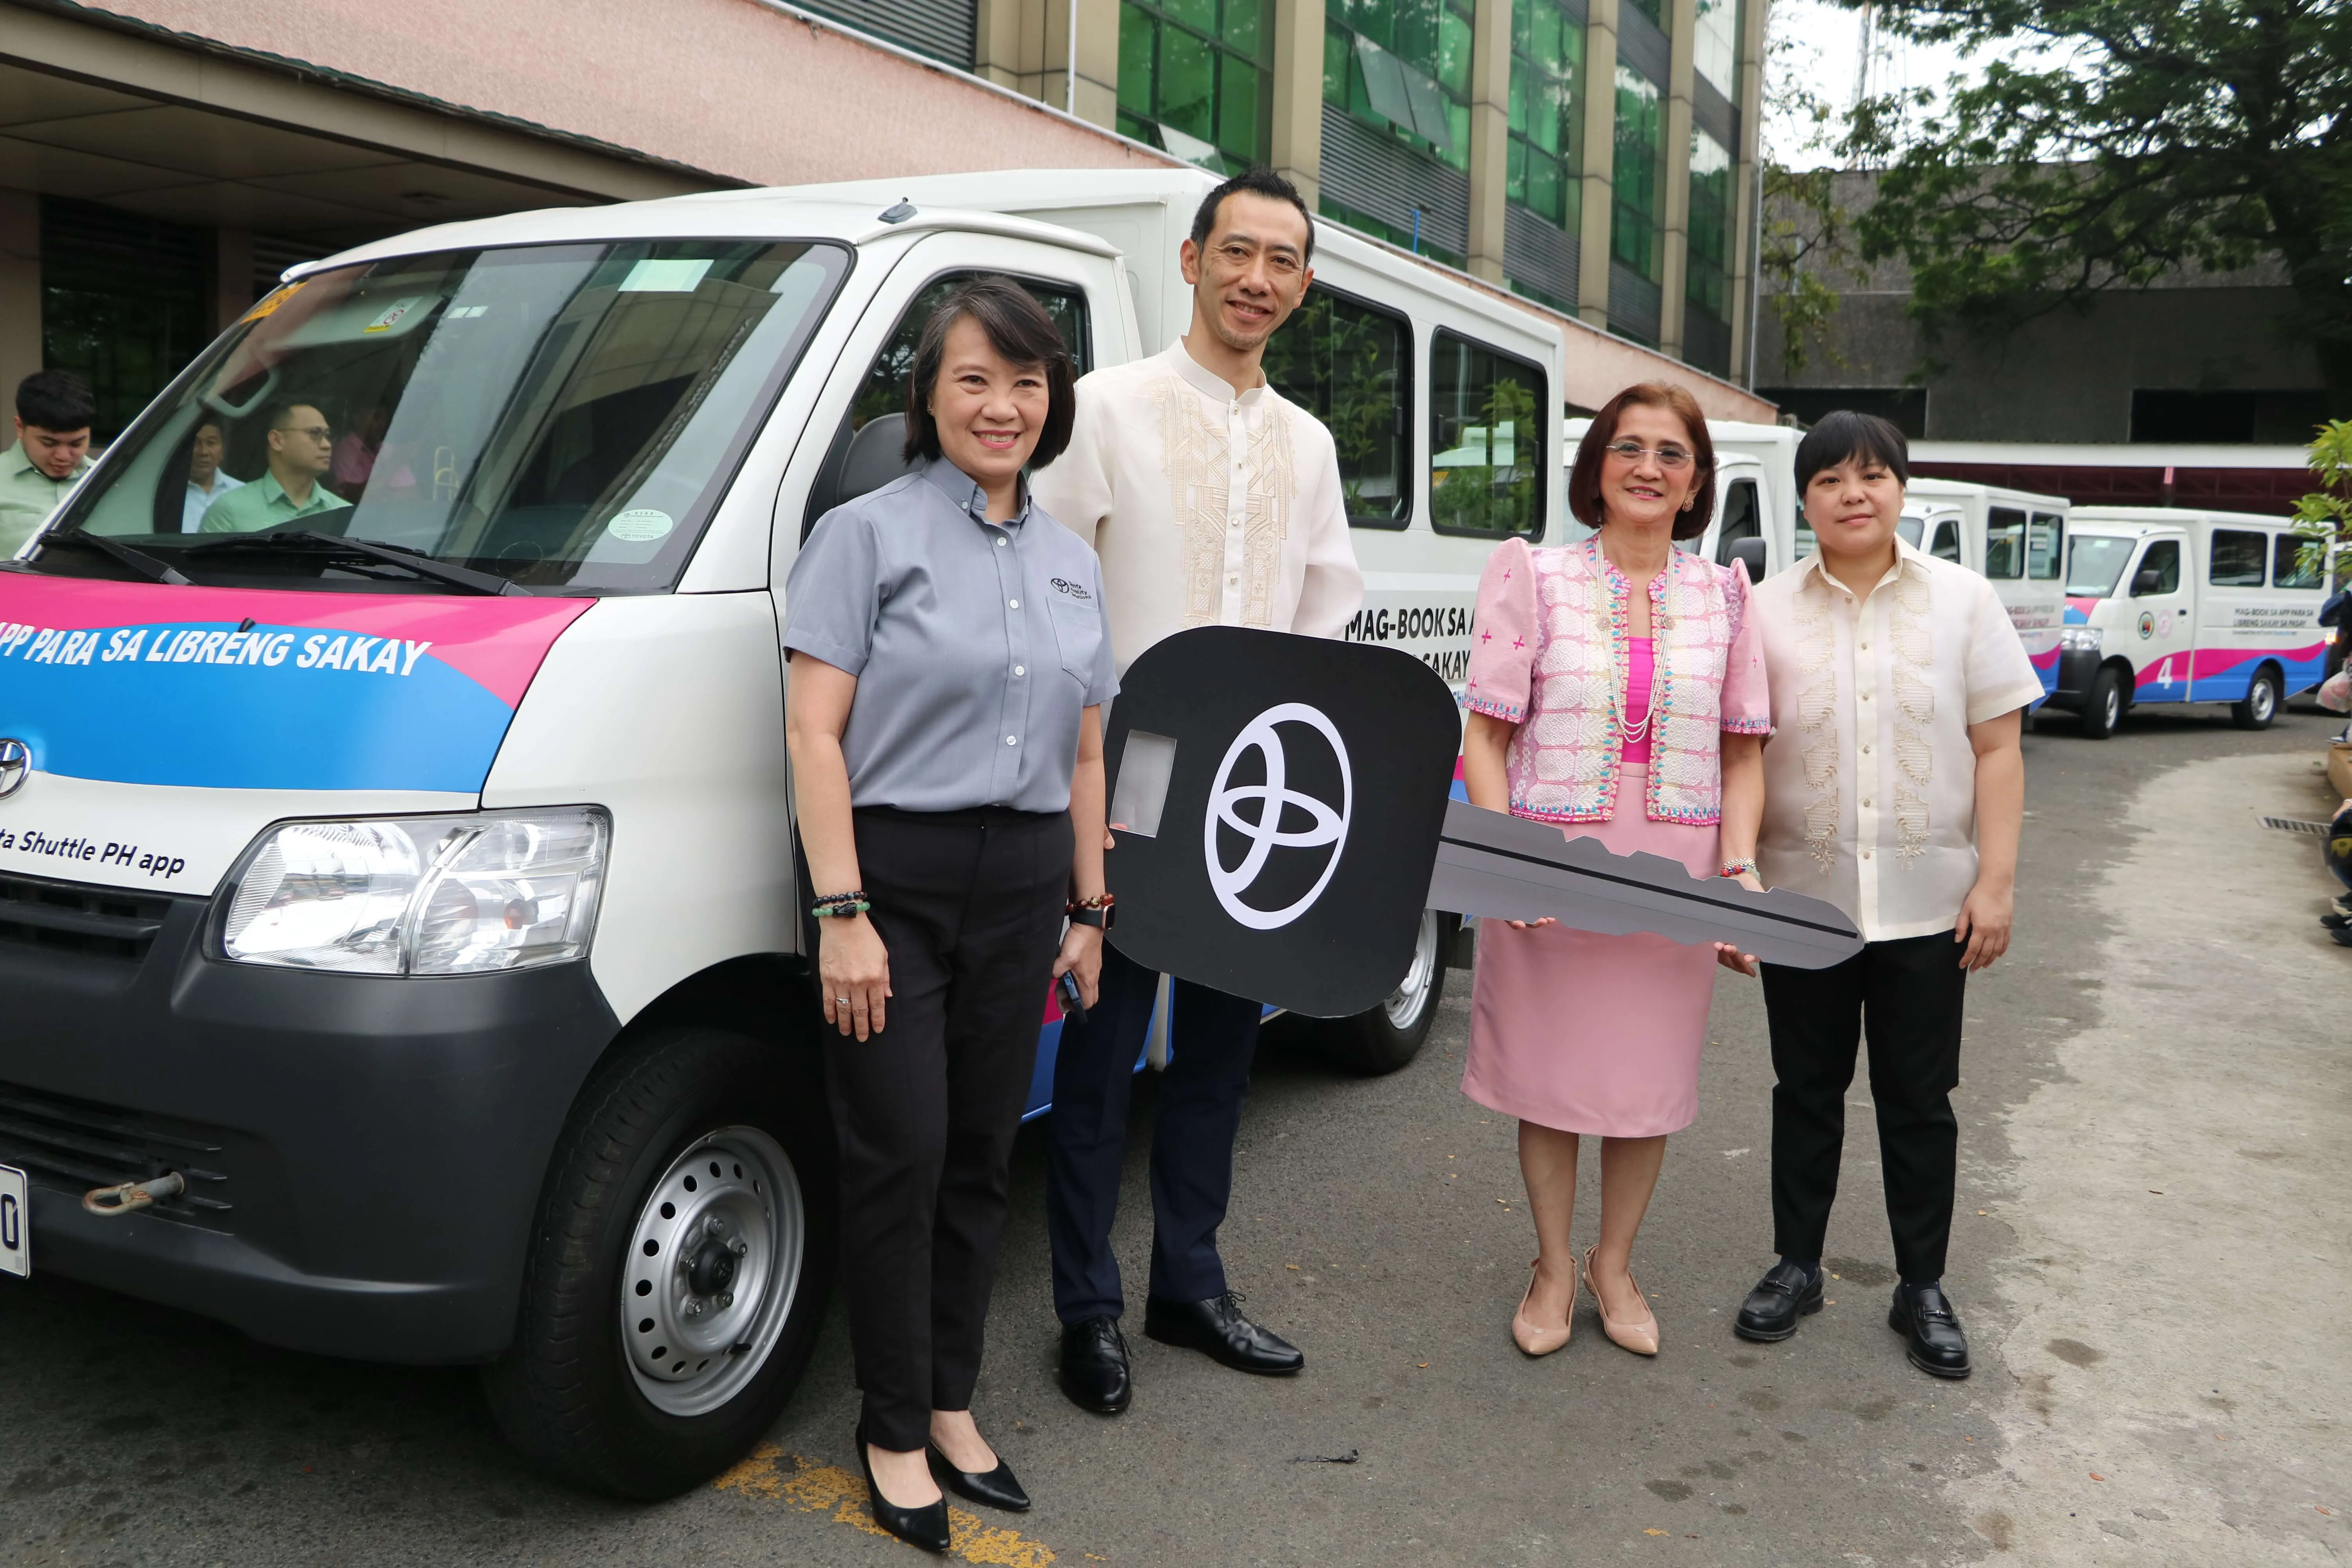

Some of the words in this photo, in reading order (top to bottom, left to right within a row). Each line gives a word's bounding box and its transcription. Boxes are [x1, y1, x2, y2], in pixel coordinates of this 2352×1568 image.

[1345, 608, 1445, 641] MAG-BOOK
[1447, 607, 1466, 636] SA
[24, 628, 102, 665] PARA
[102, 629, 148, 662] SA
[145, 630, 294, 666] LIBRENG
[296, 634, 433, 676] SAKAY
[2157, 657, 2172, 690] 4
[19, 831, 96, 861] Shuttle
[100, 842, 138, 866] PH
[138, 853, 185, 878] app
